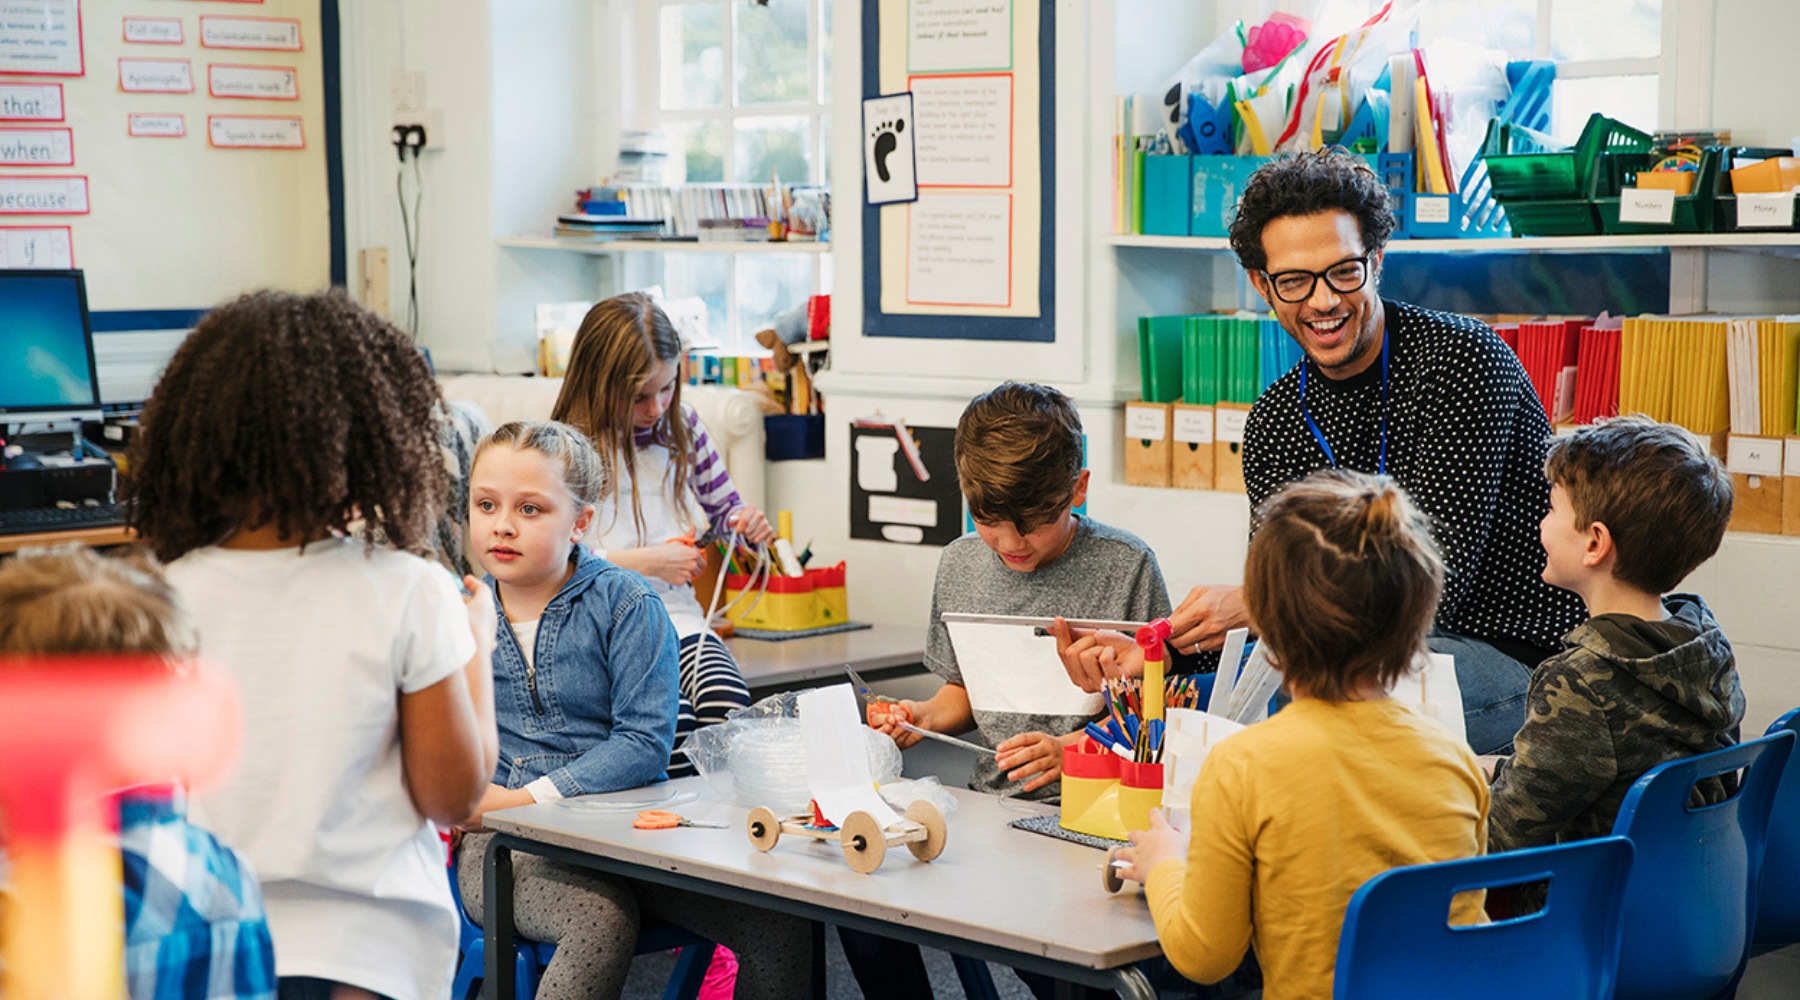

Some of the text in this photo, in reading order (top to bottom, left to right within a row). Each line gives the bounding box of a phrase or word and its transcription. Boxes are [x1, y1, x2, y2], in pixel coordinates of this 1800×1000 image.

[206, 29, 262, 41] Exclamation
[128, 73, 182, 85] Apostrophe
[4, 94, 41, 115] that
[225, 130, 255, 141] Speech
[1, 139, 51, 160] when
[1753, 204, 1777, 216] Money
[24, 237, 36, 265] if
[1748, 451, 1761, 461] Art
